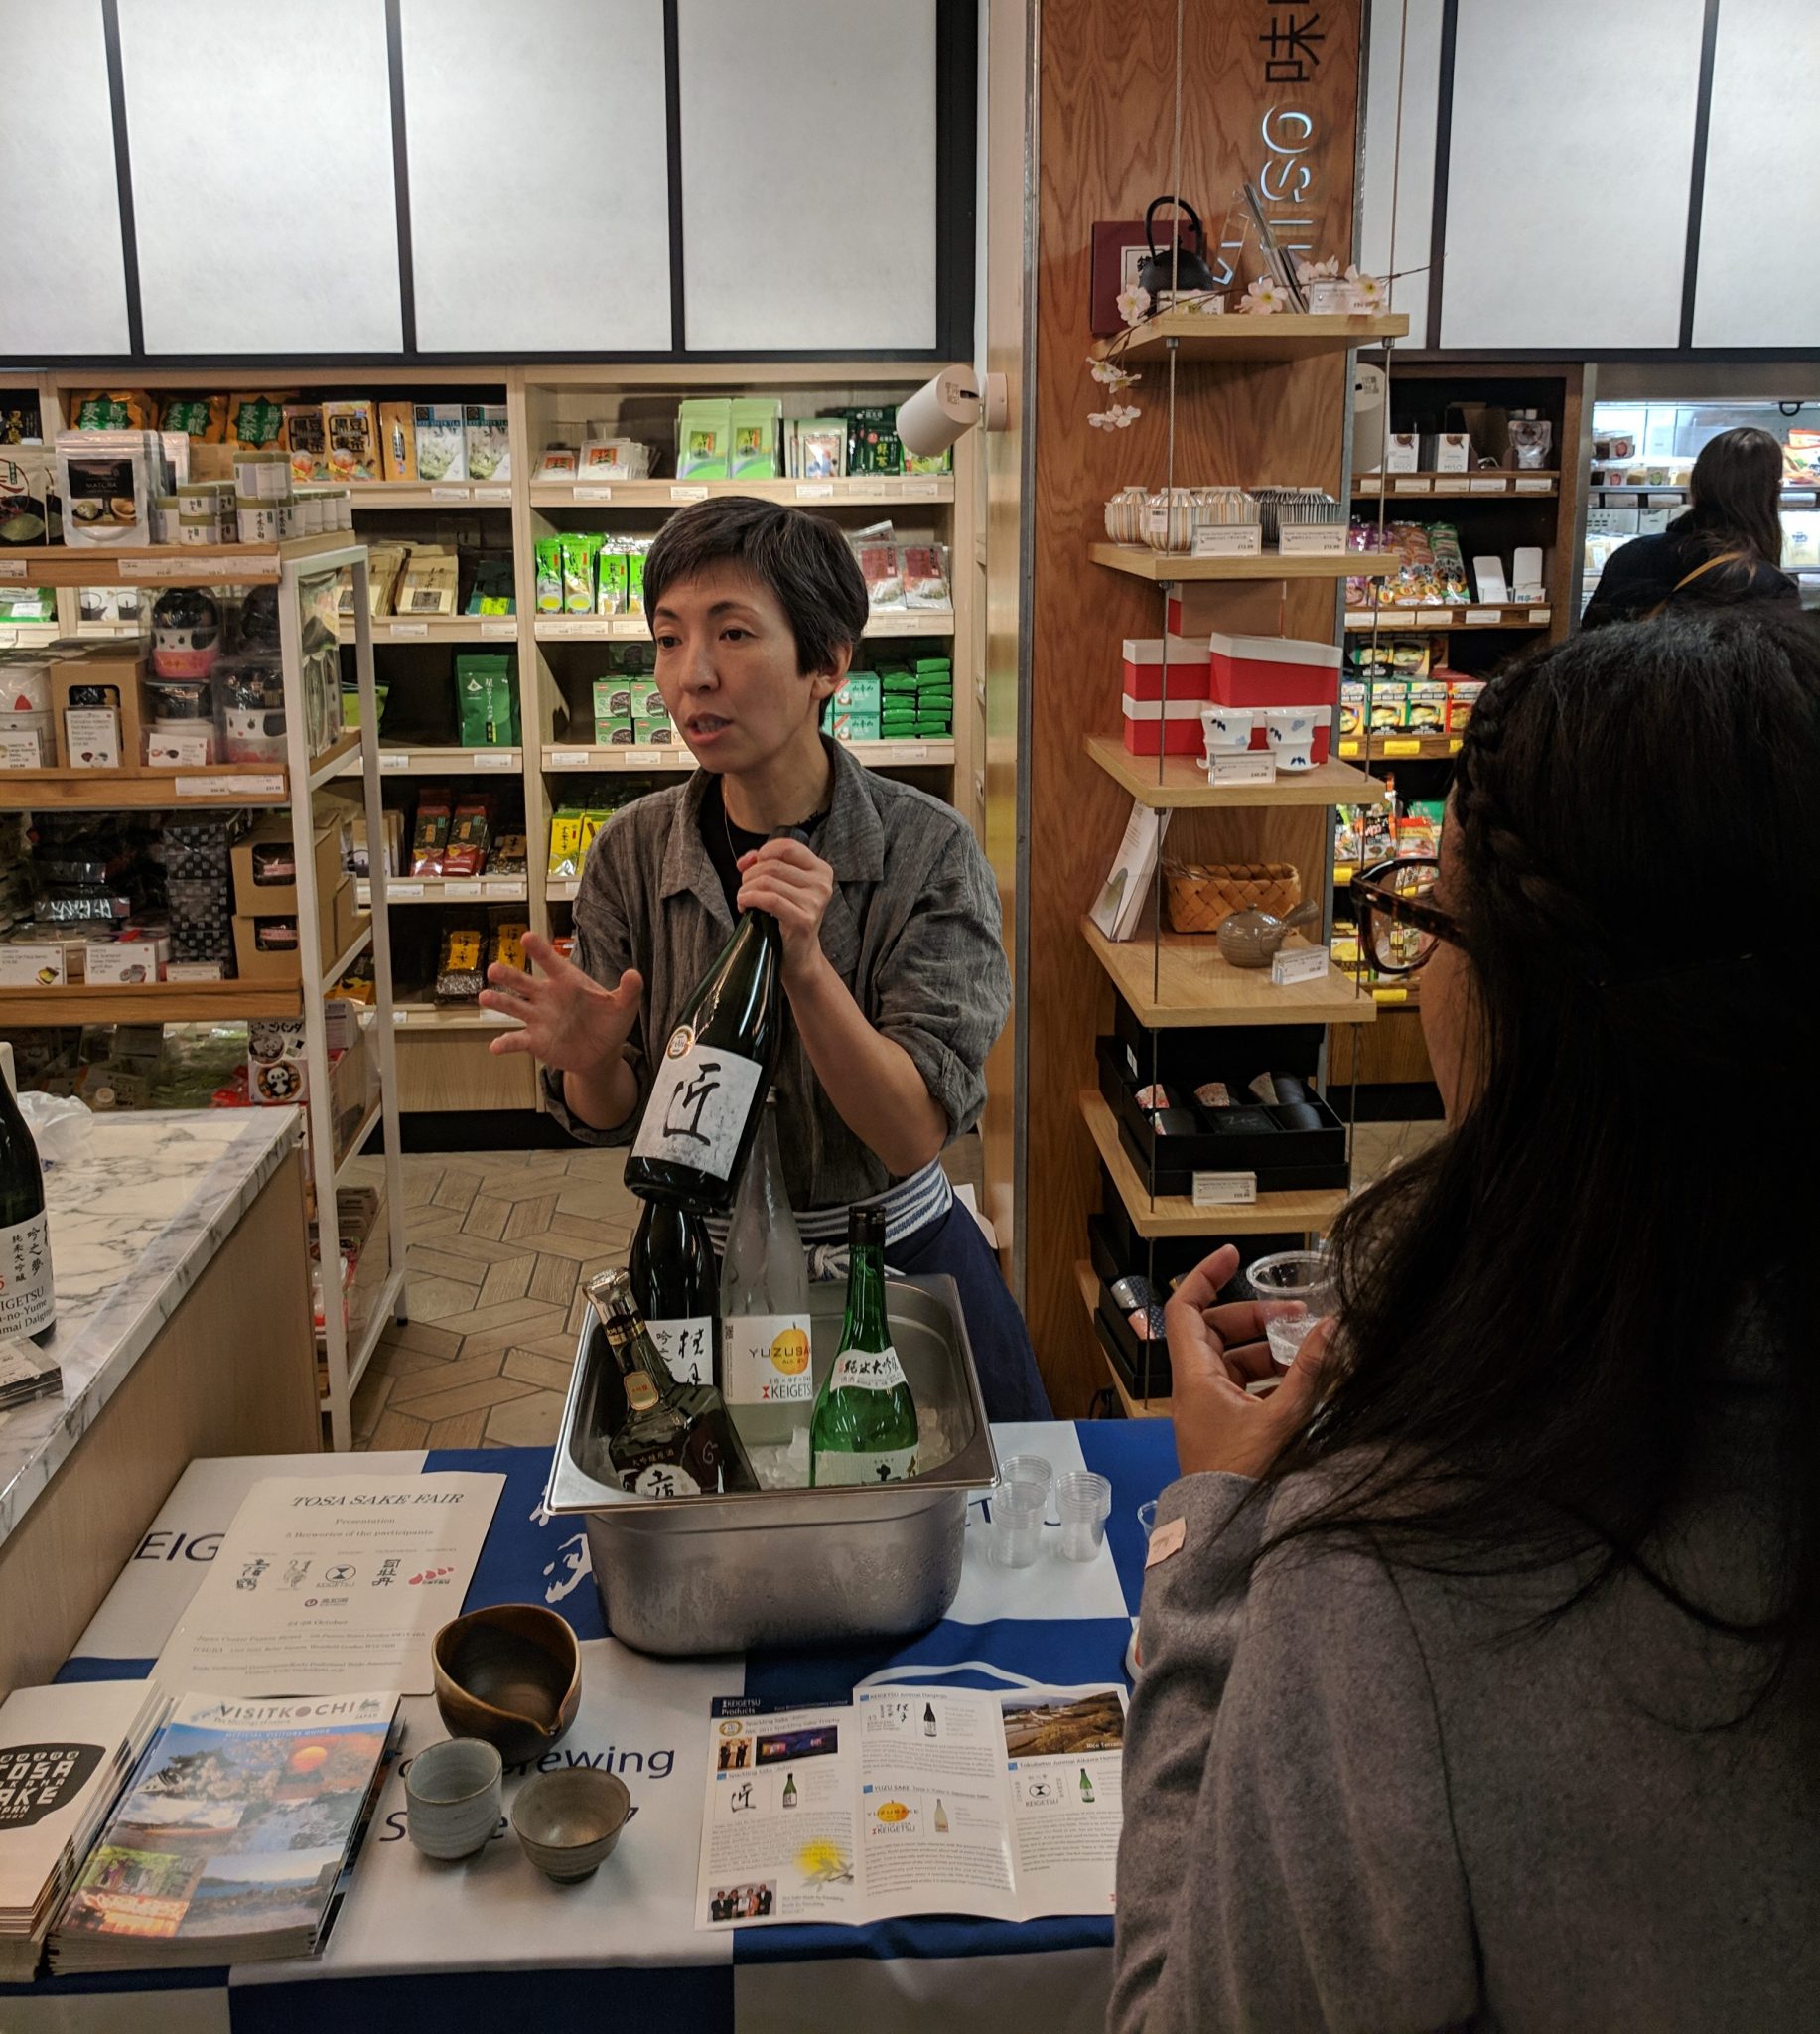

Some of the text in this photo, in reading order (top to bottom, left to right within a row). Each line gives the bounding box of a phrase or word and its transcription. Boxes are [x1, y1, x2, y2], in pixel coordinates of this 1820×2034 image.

[663, 1062, 722, 1147] 匠
[291, 1493, 464, 1507] TOSA SAKE FAIR
